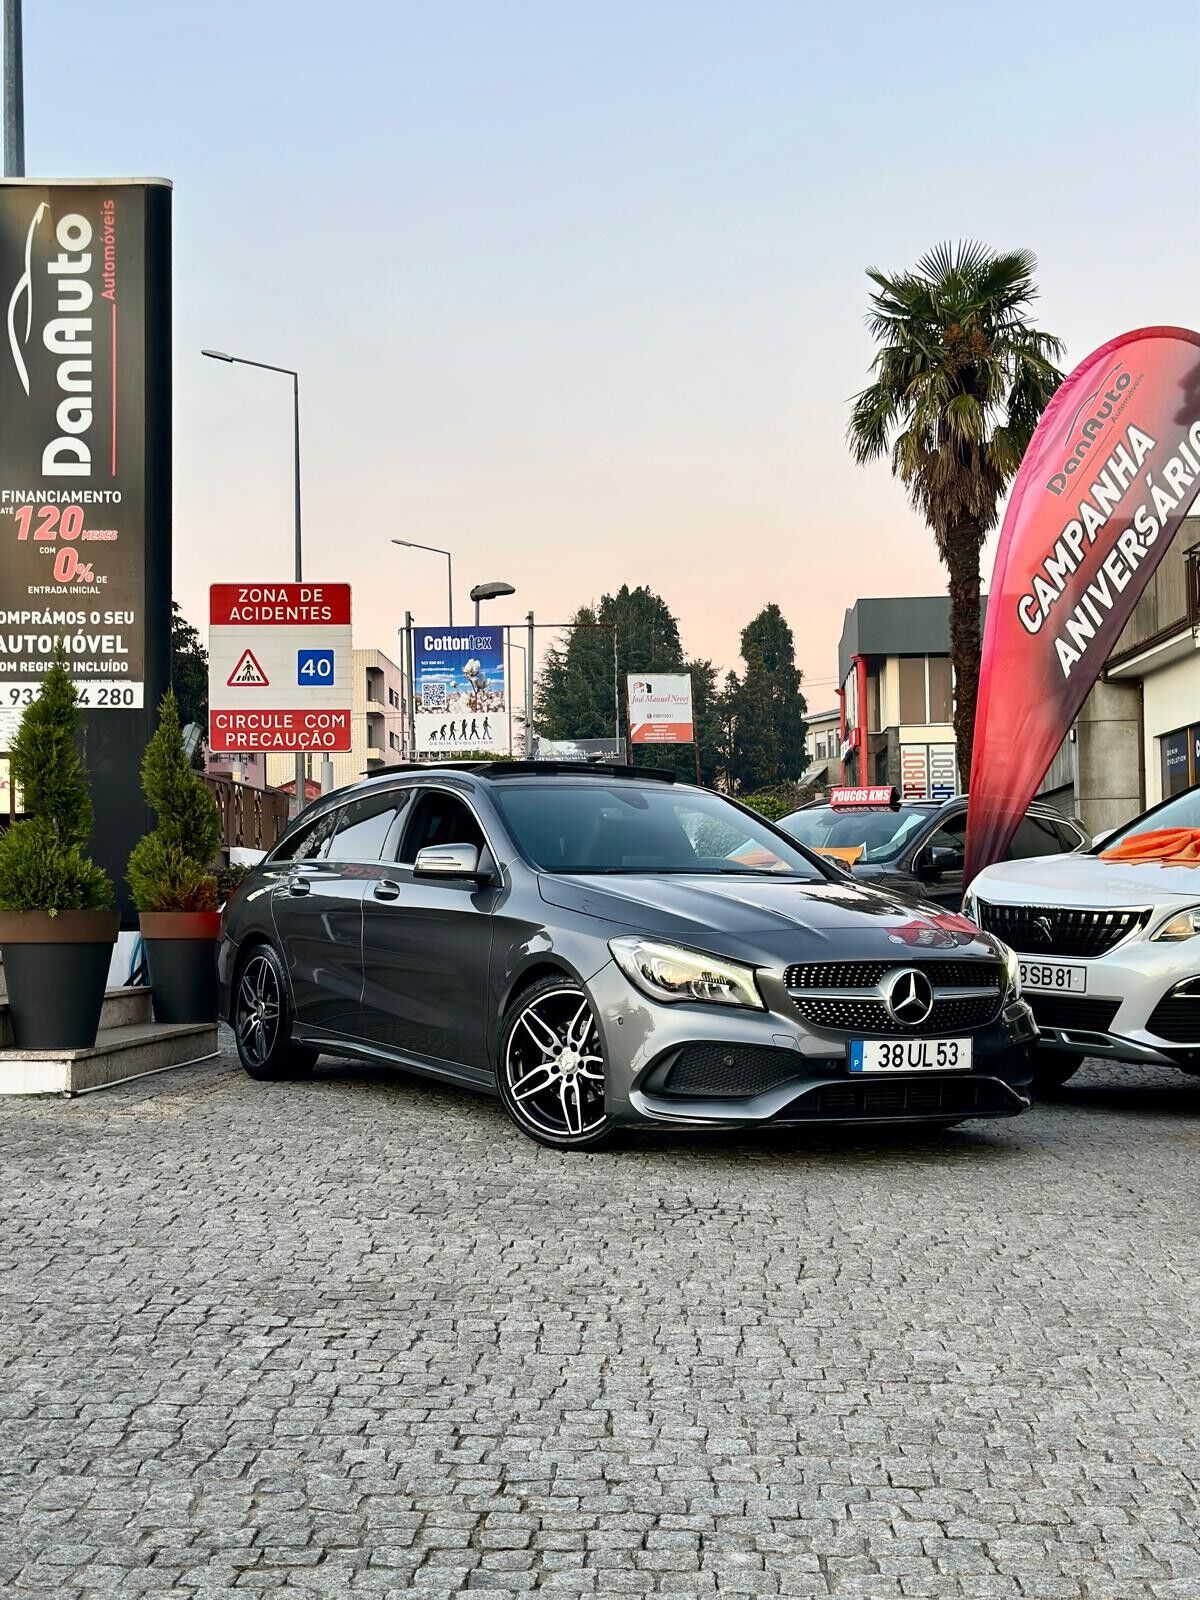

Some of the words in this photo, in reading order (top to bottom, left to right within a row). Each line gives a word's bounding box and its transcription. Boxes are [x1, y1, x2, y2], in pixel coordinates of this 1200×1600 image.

[101, 200, 115, 300] Automóveis
[42, 213, 93, 476] DanAuto
[1111, 373, 1145, 424] Automóveis
[1045, 373, 1131, 496] DanAuto
[1, 490, 122, 503] FINANCIAMENTO
[0, 506, 14, 515] ATÉ
[14, 505, 85, 541] 120
[81, 530, 118, 541] MESES
[1018, 424, 1156, 633] CAMPANHA
[53, 546, 95, 583] 0%
[28, 586, 68, 594] ENTRADA
[69, 586, 101, 594] INICIAL
[238, 589, 289, 603] ZONA
[300, 589, 323, 603] DE
[0, 607, 86, 625] OMPRÁMOS
[90, 611, 101, 625] O
[103, 611, 134, 625] SEU
[229, 606, 332, 621] ACIDENTES
[424, 635, 492, 651] Cottontex
[73, 658, 129, 672] INCLUÍDO
[300, 658, 331, 678] 40
[97, 688, 134, 705] 280
[215, 714, 293, 729] CIRCULE
[304, 714, 345, 728] COM
[225, 730, 336, 750] PRECAUÇÃO
[832, 790, 867, 802] POUCOS
[869, 789, 890, 801] KMS
